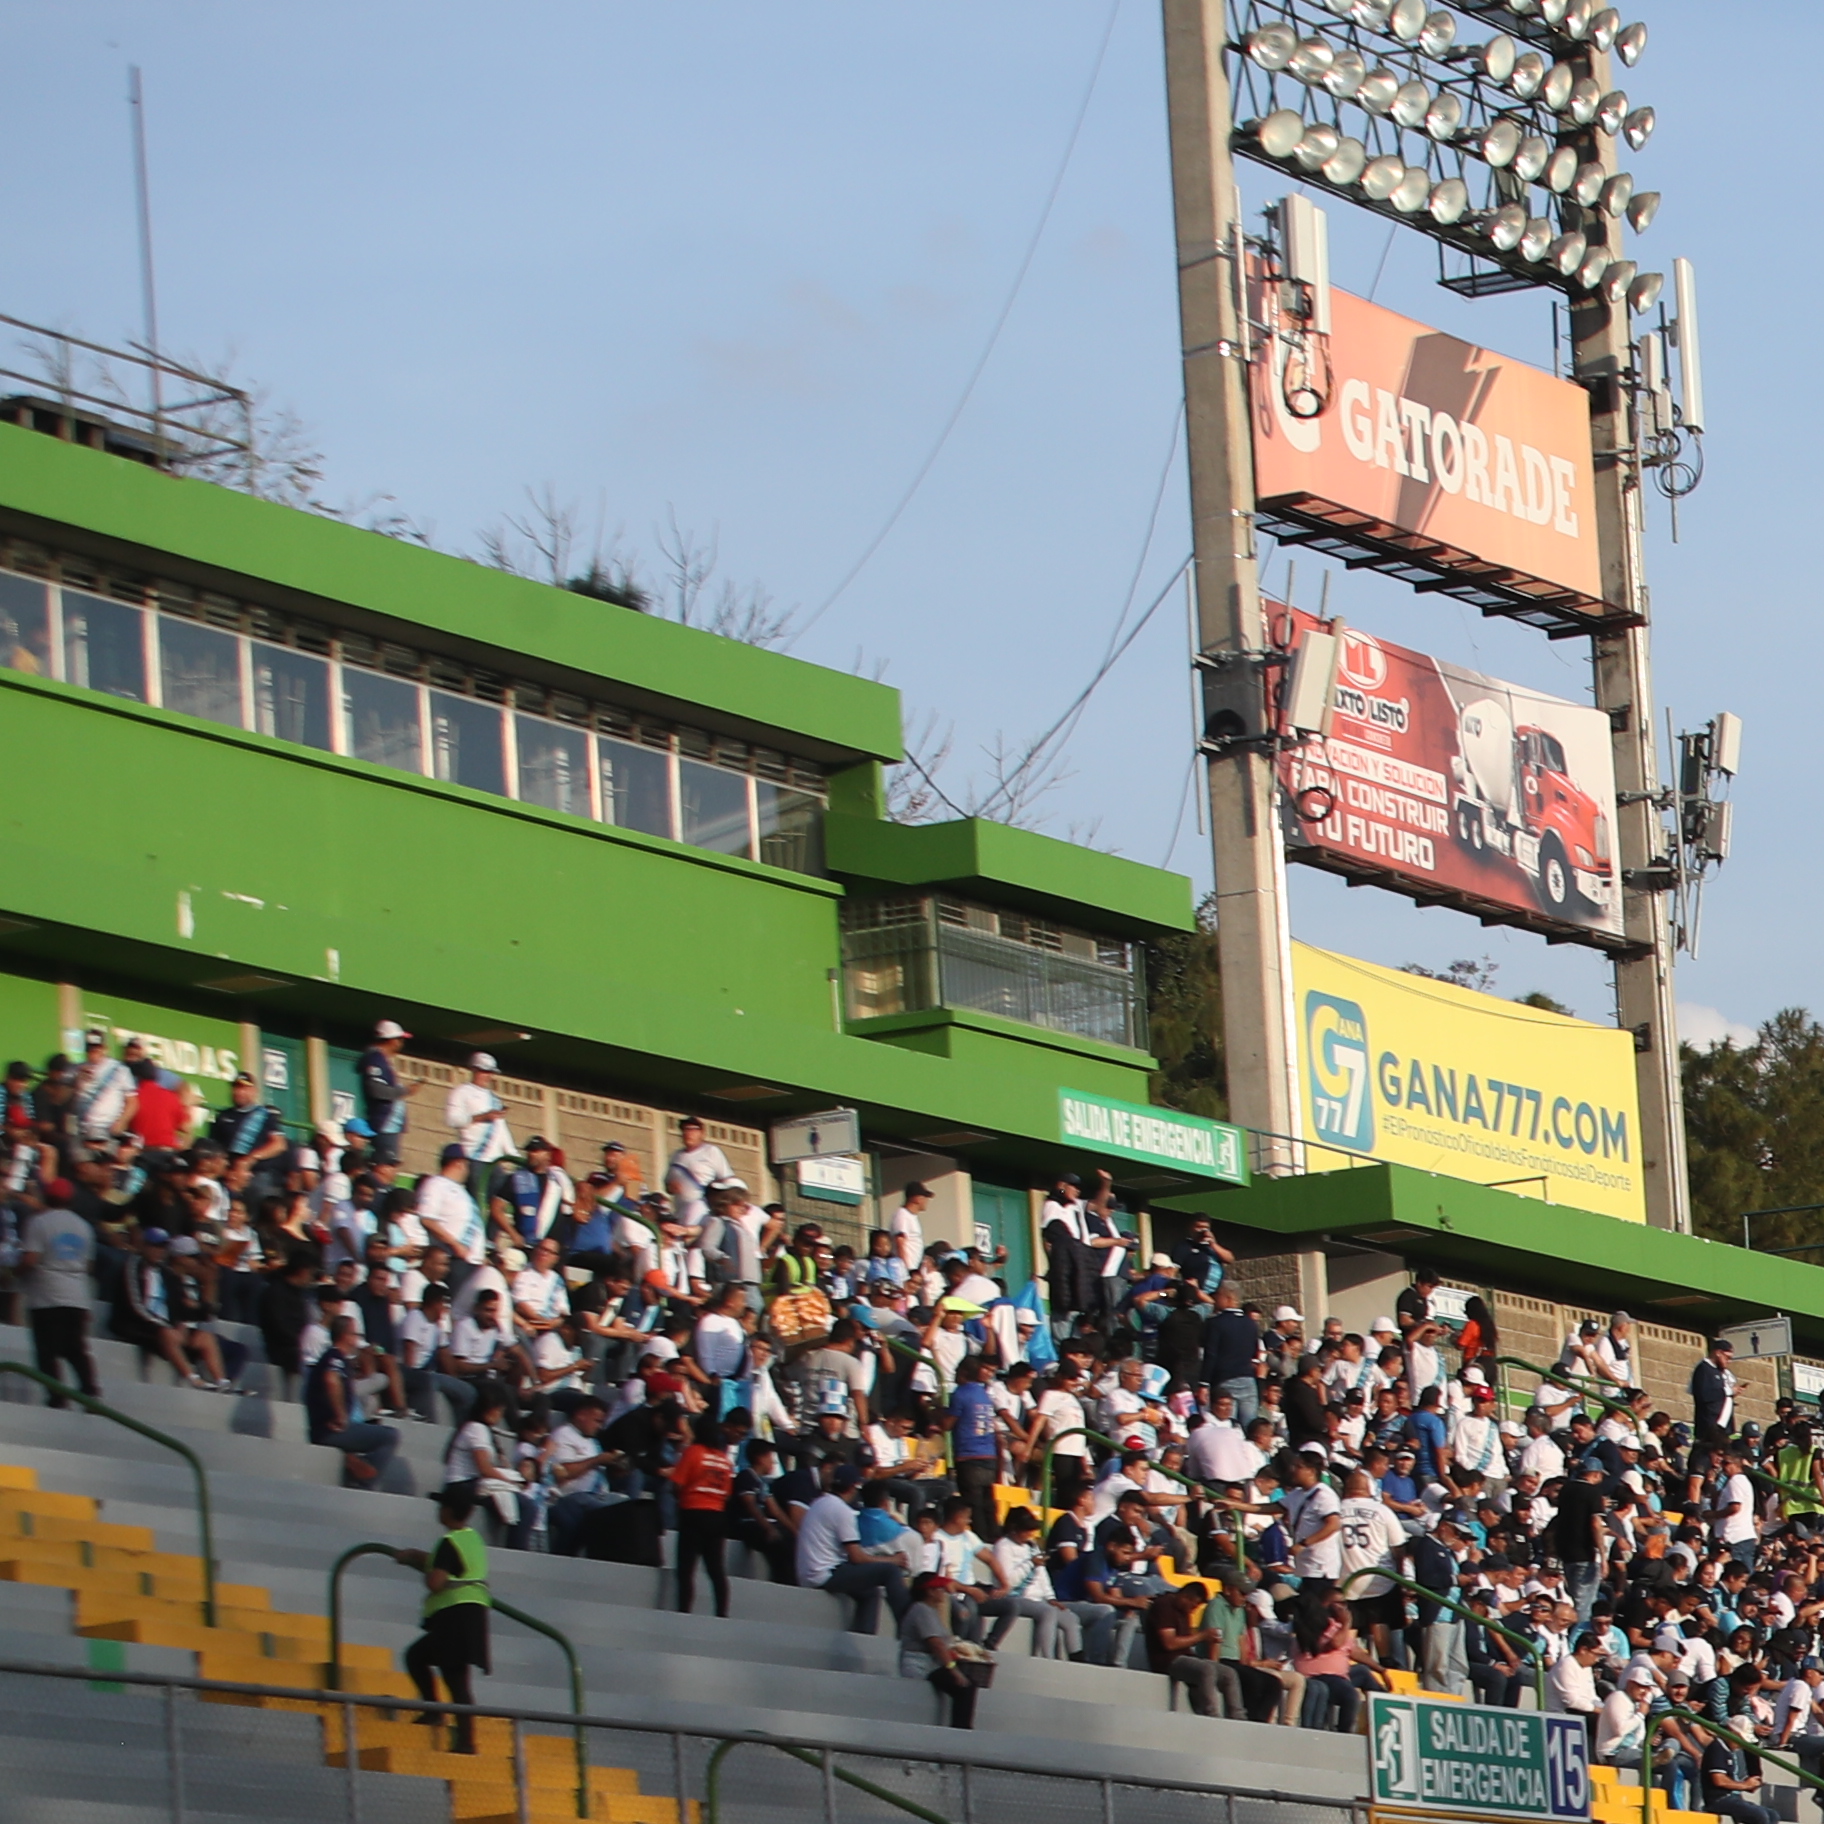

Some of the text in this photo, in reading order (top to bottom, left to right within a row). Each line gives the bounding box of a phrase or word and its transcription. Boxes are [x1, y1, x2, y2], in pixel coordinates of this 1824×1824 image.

[1341, 378, 1579, 538] GATORADE
[1369, 697, 1406, 730] LISTO
[1290, 761, 1449, 836] PARA CONSTRUIR
[1310, 802, 1435, 870] TU FUTURO
[113, 1027, 238, 1082] TENDAS
[1063, 1098, 1215, 1167] SALIDA DE EMERGENCIA
[1379, 1051, 1629, 1163] GANA777.COM
[1430, 1710, 1531, 1759] SALIDA DE
[1549, 1726, 1588, 1810] 15
[1421, 1758, 1548, 1808] EMERGENCIA
